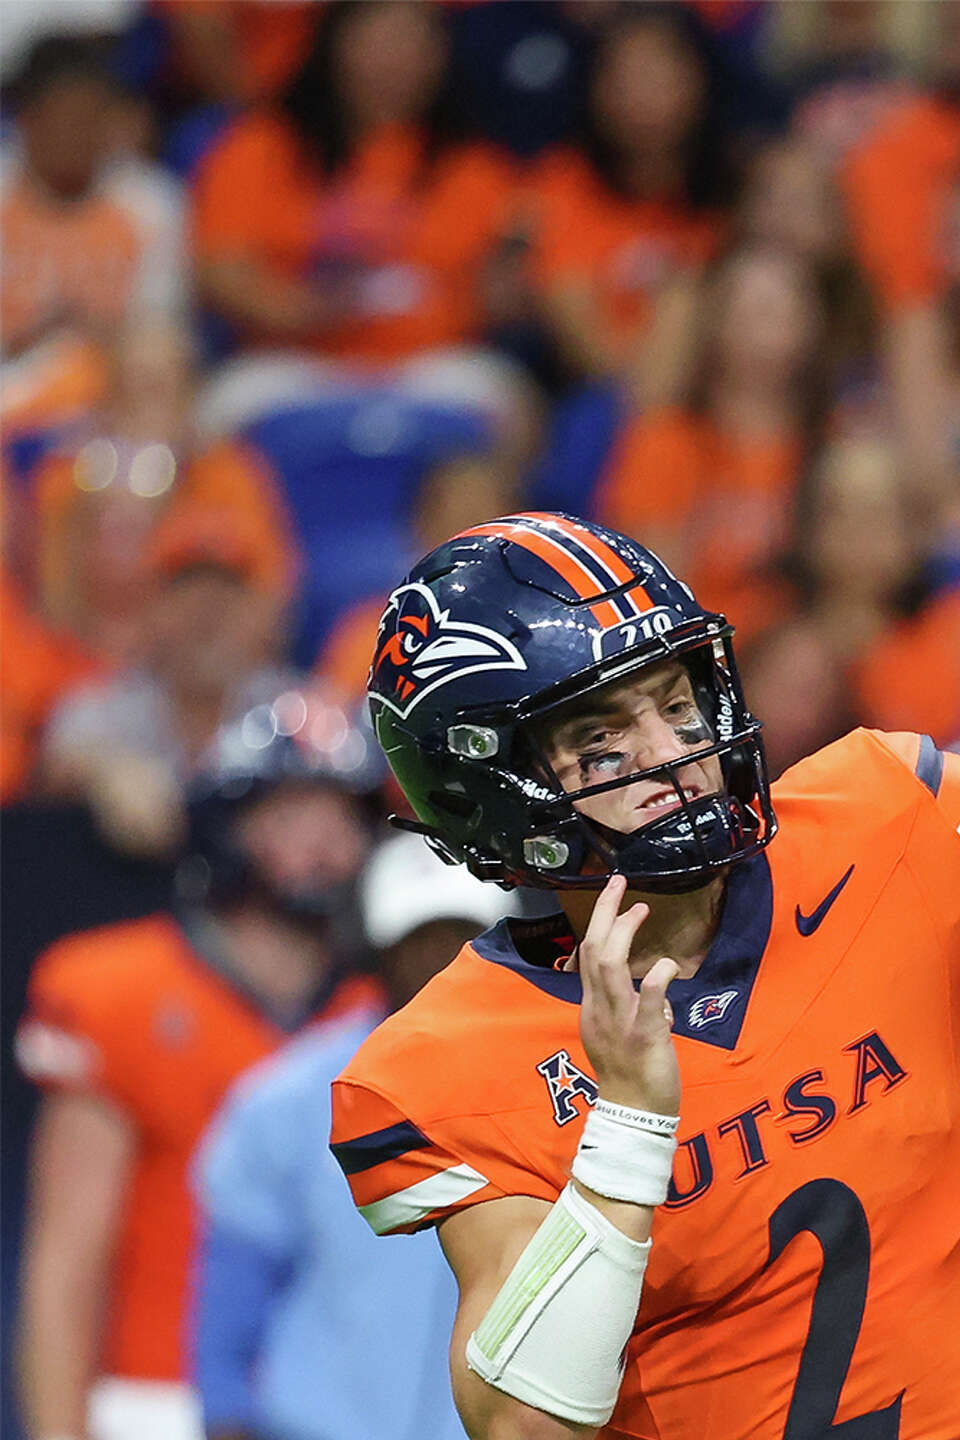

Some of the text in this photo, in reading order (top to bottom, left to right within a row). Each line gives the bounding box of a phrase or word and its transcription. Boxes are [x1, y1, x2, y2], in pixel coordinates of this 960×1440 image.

[619, 612, 674, 648] 210
[716, 693, 733, 742] iddell
[618, 1109, 653, 1126] Loves
[663, 1031, 909, 1210] UTSA
